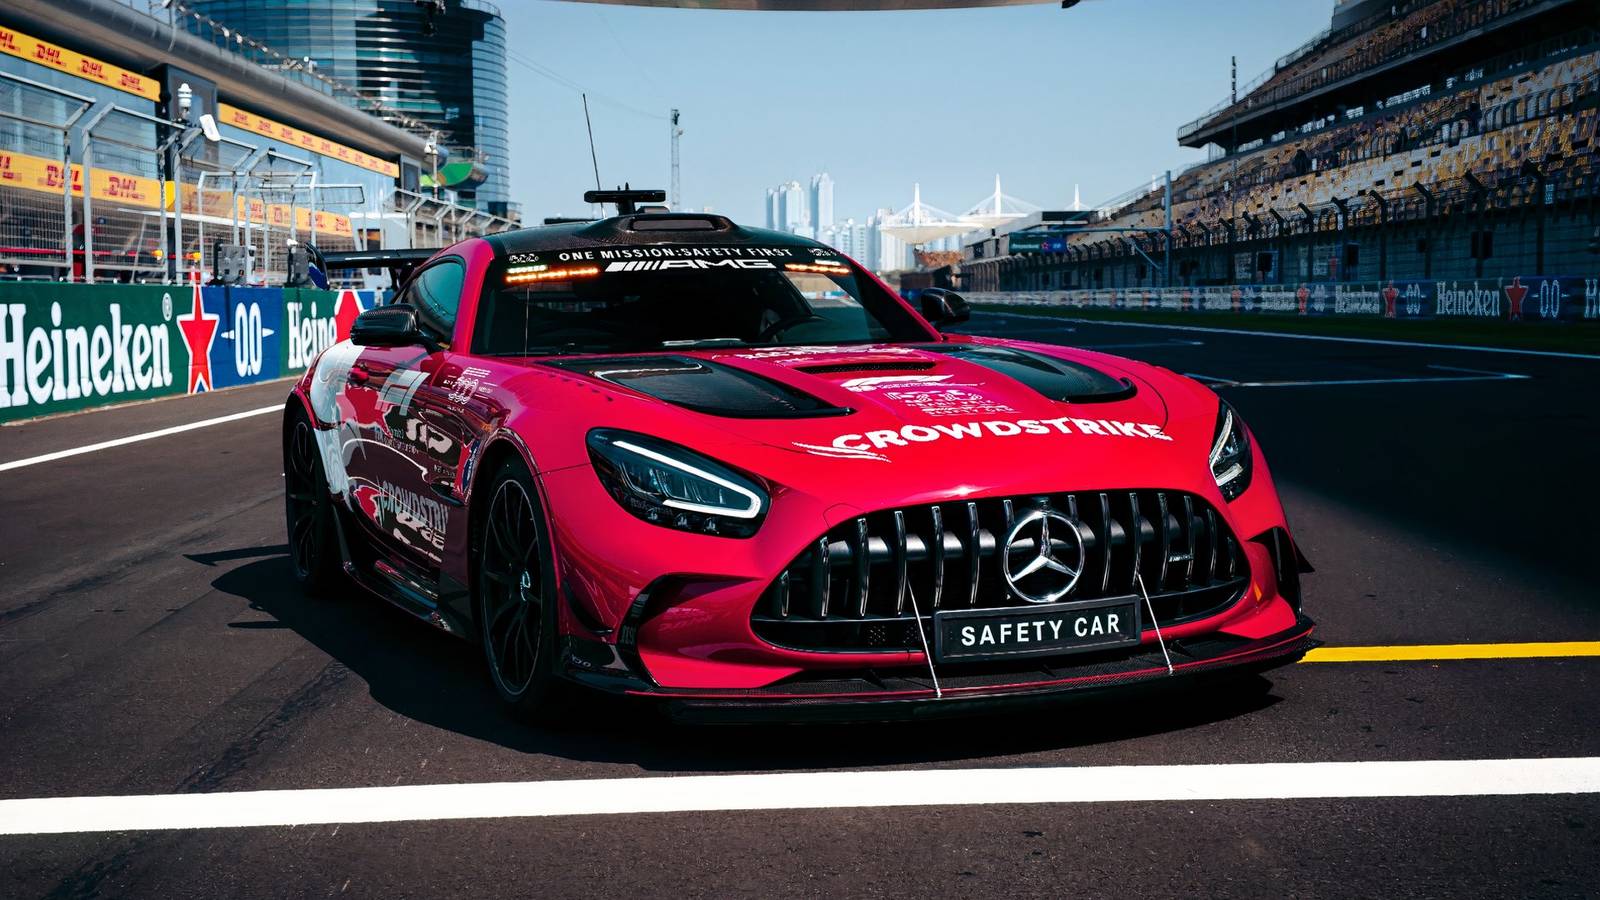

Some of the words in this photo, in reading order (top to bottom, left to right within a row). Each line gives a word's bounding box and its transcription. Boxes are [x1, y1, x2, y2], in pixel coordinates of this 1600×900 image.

[558, 250, 595, 262] ONE
[747, 247, 793, 258] FIRST
[1436, 280, 1501, 317] Heineken
[0, 301, 172, 408] Heineken
[832, 415, 1174, 452] CROWDSTRIKE
[960, 618, 1065, 647] SAFETY
[1074, 612, 1121, 637] CAR
